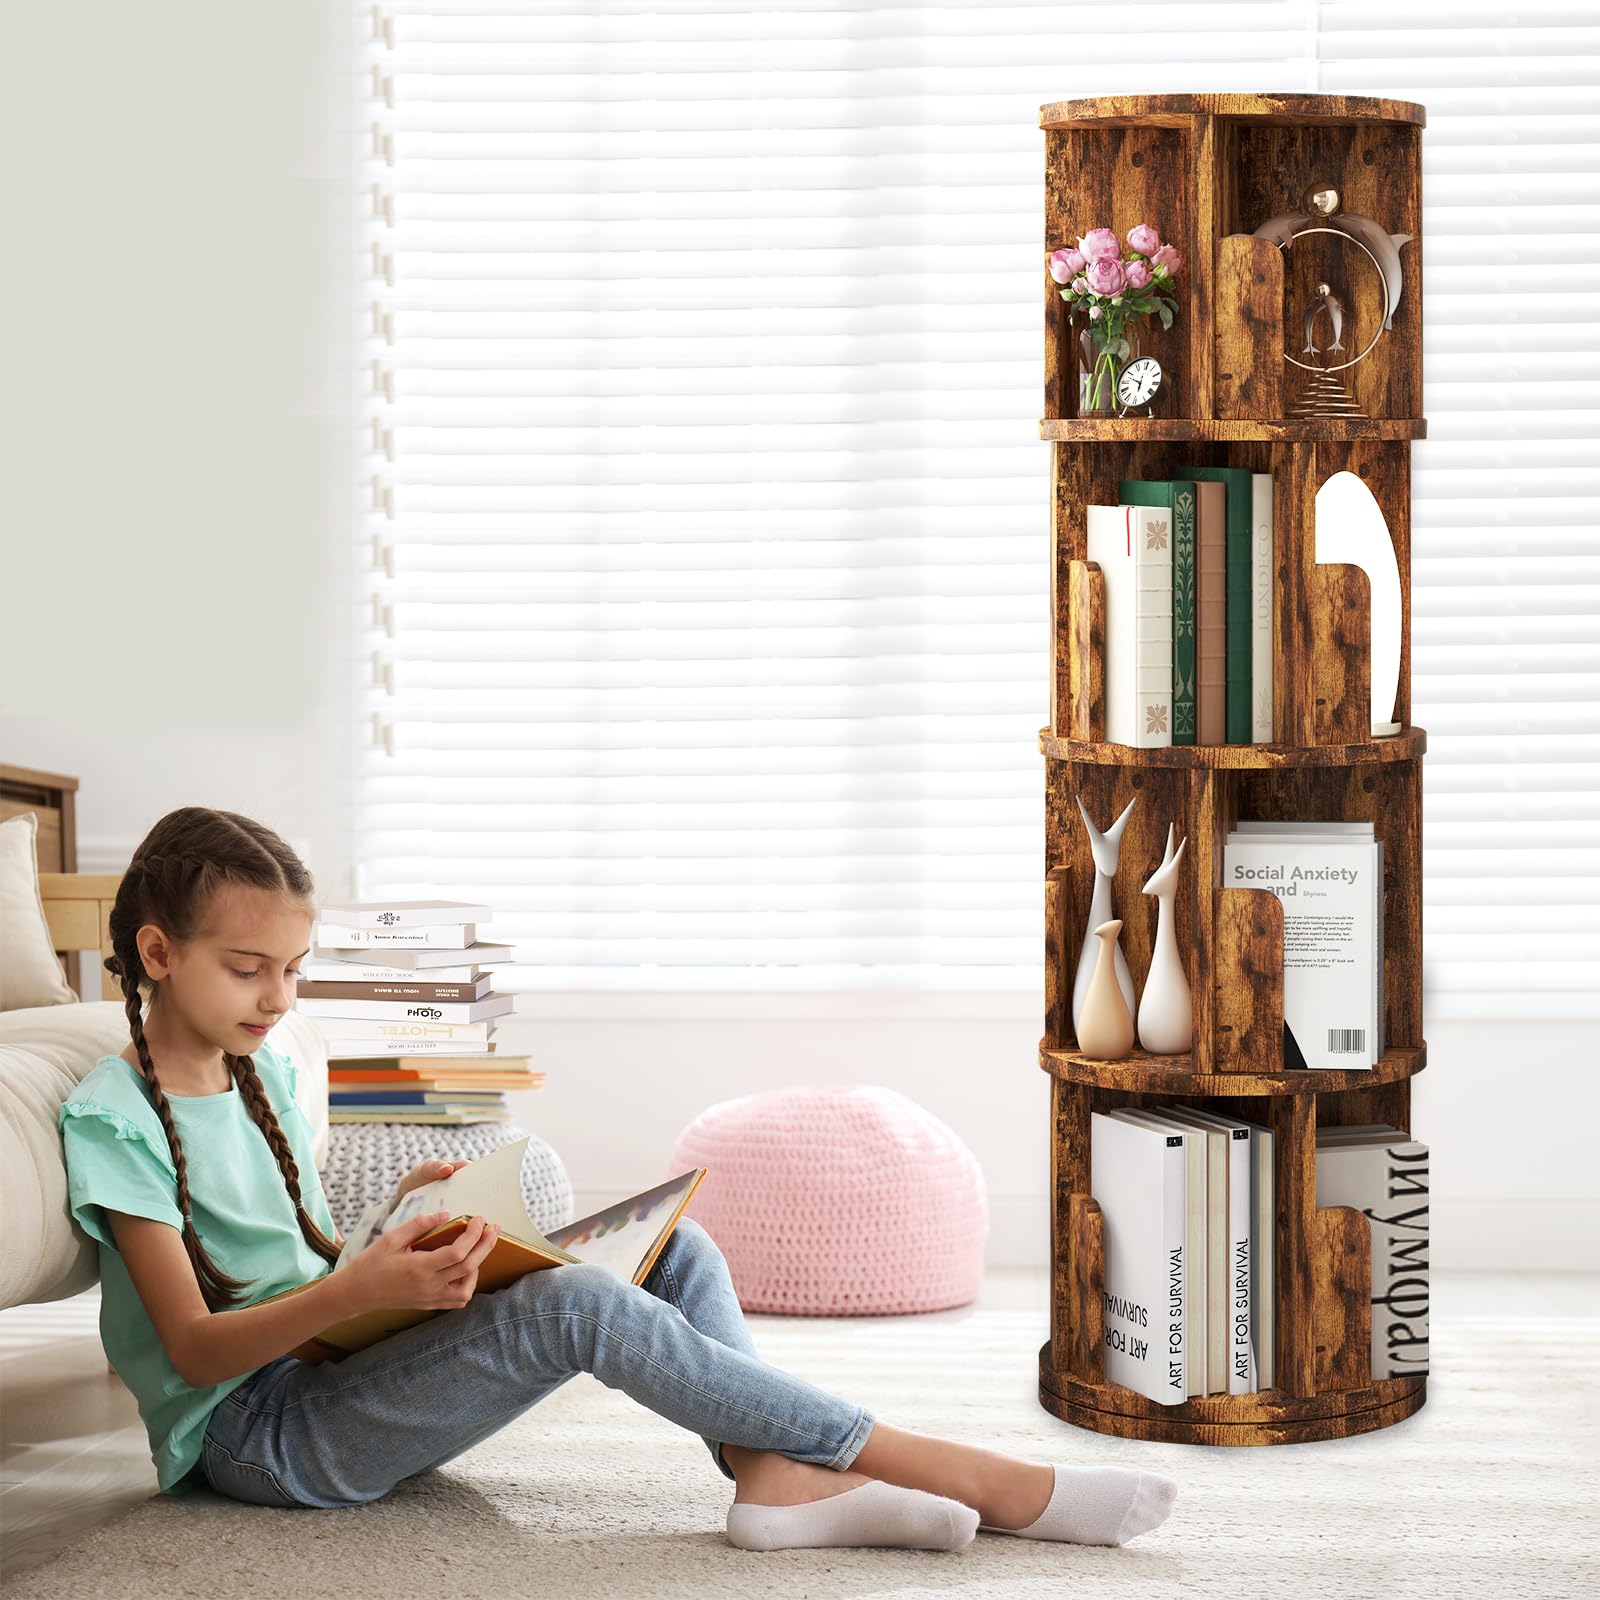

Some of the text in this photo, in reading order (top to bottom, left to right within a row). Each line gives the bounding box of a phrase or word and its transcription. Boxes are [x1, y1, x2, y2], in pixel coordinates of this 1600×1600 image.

[1258, 524, 1271, 631] LUXDECO
[1234, 865, 1358, 885] Social Anxiety
[1266, 882, 1297, 896] and
[407, 1006, 442, 1017] PHOTO
[1104, 1292, 1148, 1328] SURVIVAL
[1170, 1246, 1182, 1388] ART FOR SURVIVAL
[1236, 1238, 1248, 1380] ART FOR SURVIVAL
[1105, 1326, 1148, 1362] ART FOR
